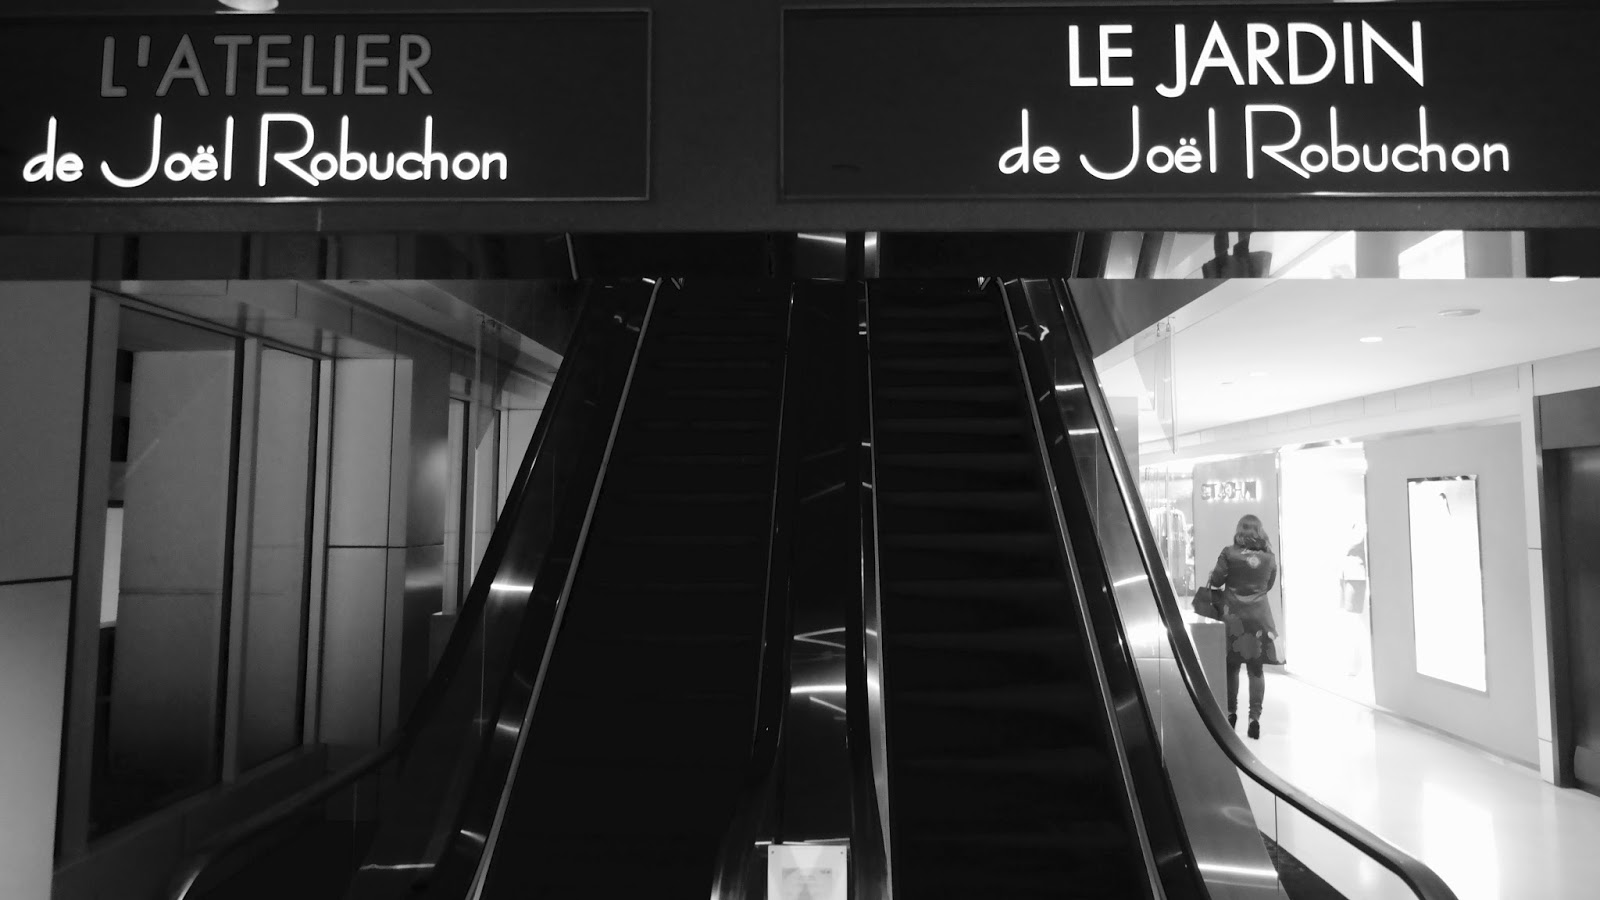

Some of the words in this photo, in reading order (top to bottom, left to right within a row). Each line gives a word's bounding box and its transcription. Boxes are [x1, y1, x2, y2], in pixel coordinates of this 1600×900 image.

[101, 34, 432, 97] L'ATELIER
[1069, 23, 1133, 86] LE
[1155, 20, 1423, 97] JARDIN
[23, 116, 83, 183] de
[101, 113, 234, 187] Joël
[259, 113, 507, 187] Robuchon
[998, 109, 1060, 175] de
[1080, 105, 1217, 180] Joël
[1245, 104, 1509, 179] Robuchon
